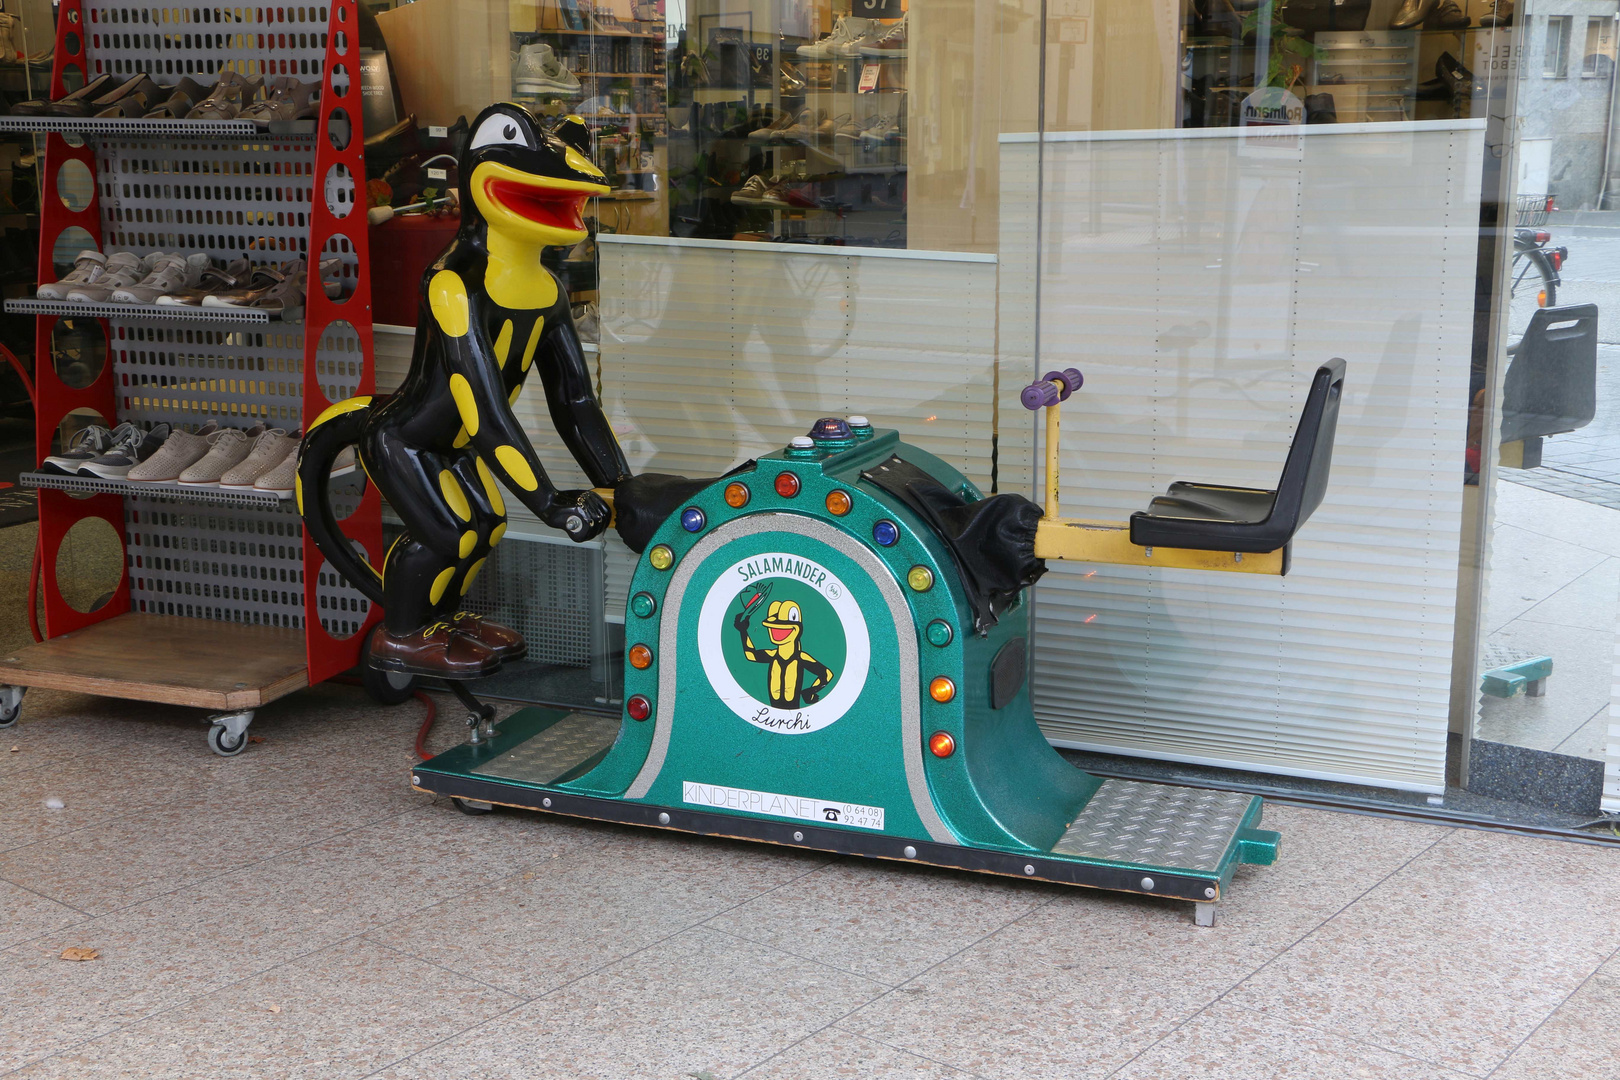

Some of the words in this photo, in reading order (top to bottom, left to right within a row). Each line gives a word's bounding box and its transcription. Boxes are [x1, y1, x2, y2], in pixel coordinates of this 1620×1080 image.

[737, 557, 827, 588] SALAMANDER
[751, 707, 811, 730] Lurchi
[684, 784, 820, 818] KINDERPLANET
[854, 806, 865, 815] 64
[844, 815, 855, 824] 92
[858, 817, 868, 826] 47
[871, 818, 881, 828] 74
